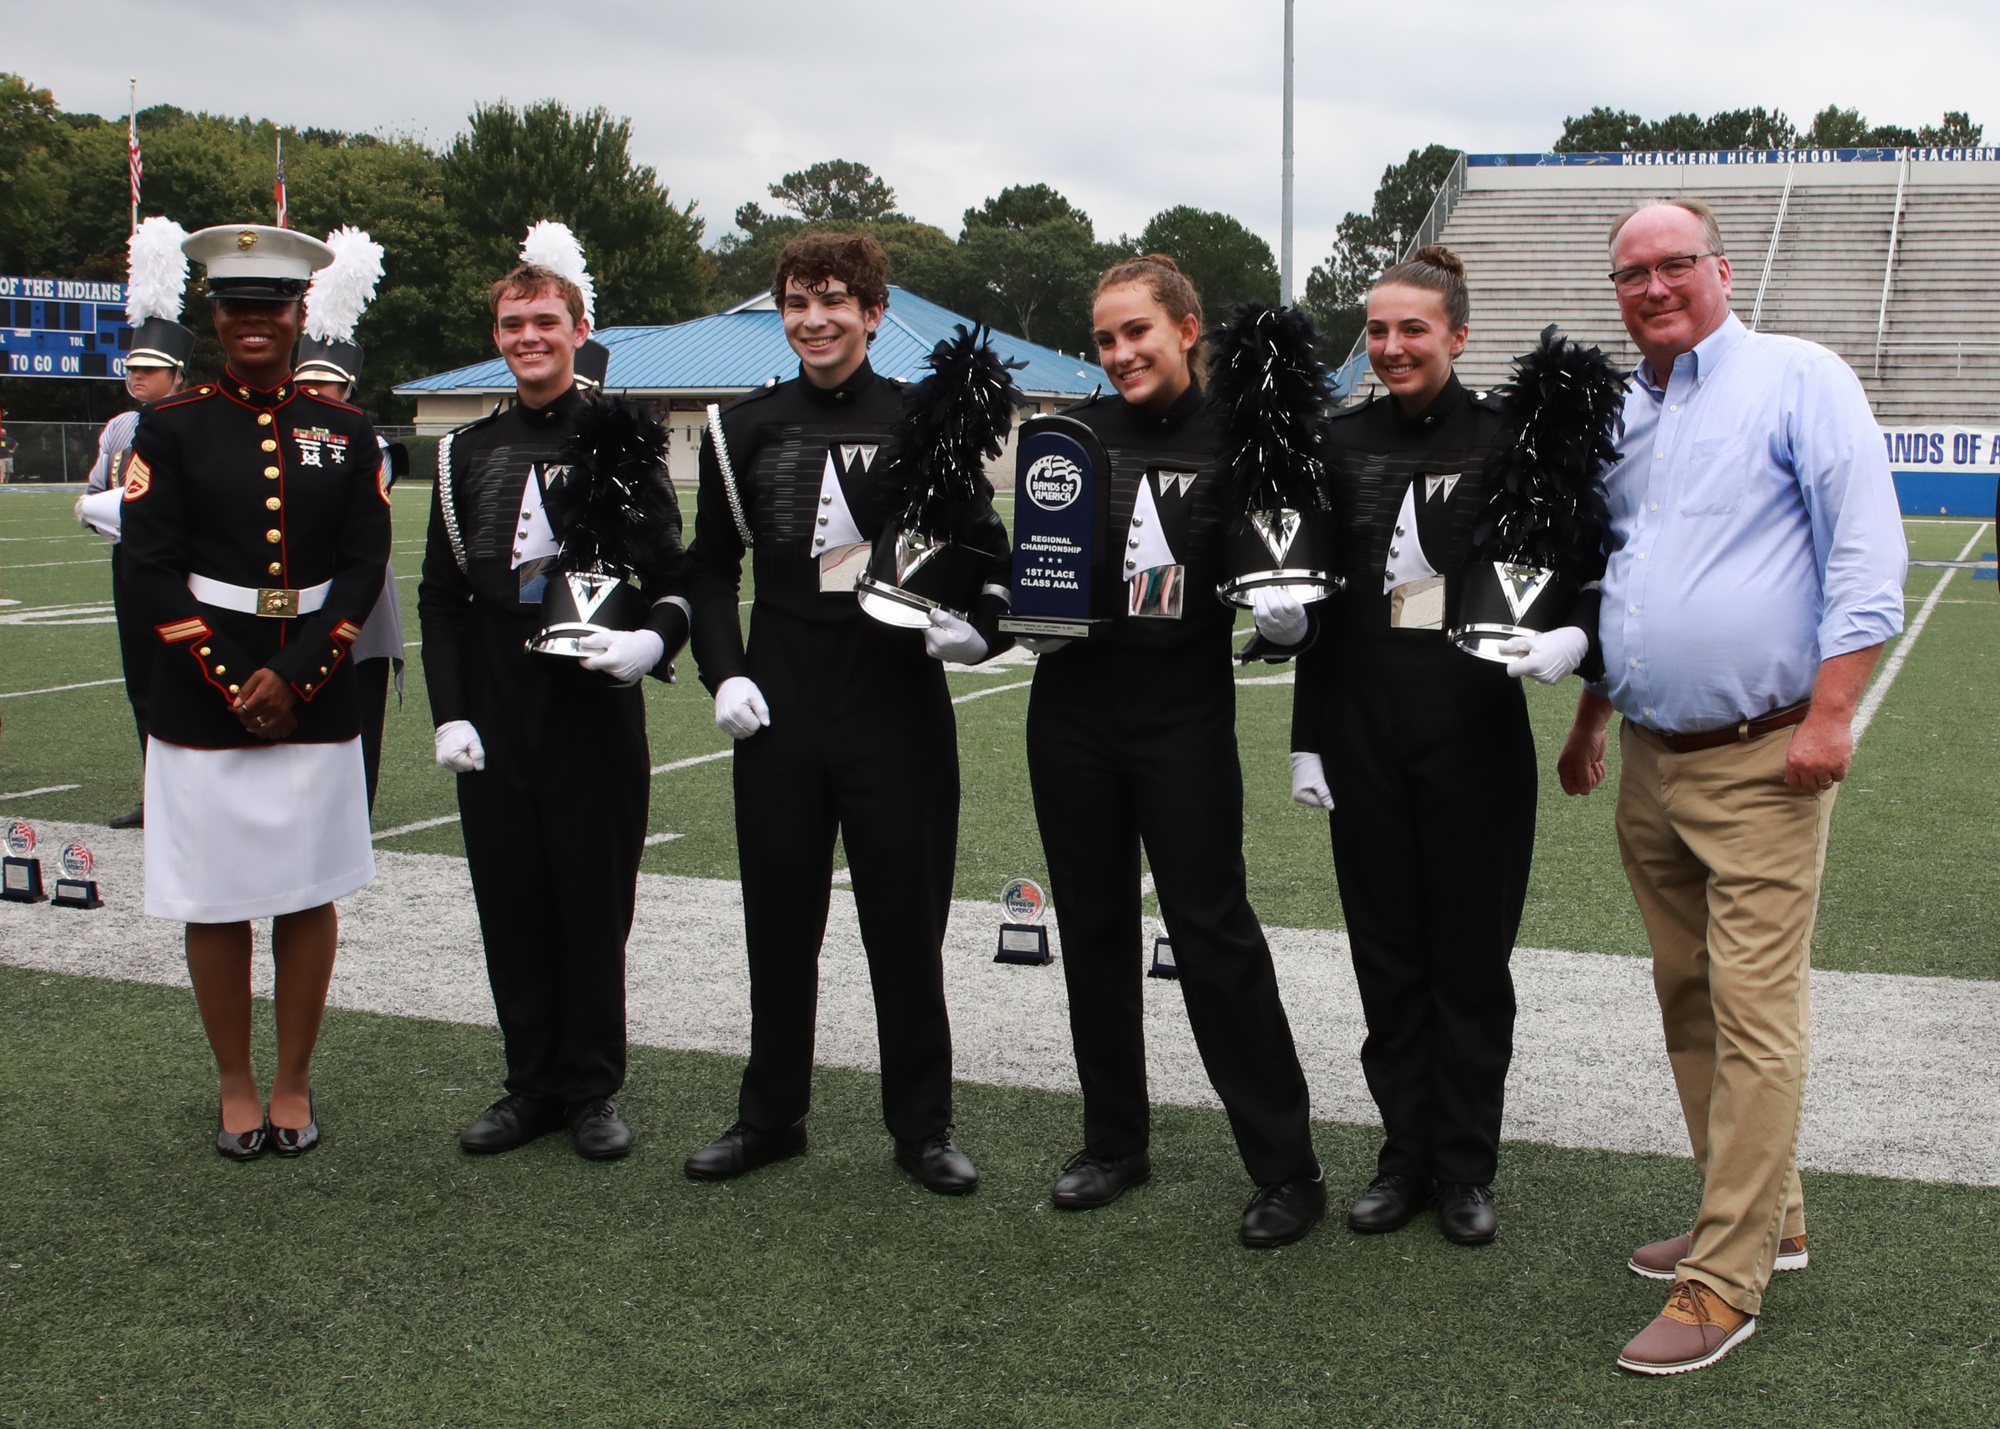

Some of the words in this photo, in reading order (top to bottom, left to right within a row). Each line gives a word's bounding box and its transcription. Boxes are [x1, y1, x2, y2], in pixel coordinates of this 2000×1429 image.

[1622, 151, 1718, 165] MCEACHERN
[1727, 151, 1767, 164] HIGH
[1776, 150, 1841, 163] SCHOOL
[1895, 148, 1996, 161] MCEACHERN
[0, 277, 19, 296] OF
[23, 279, 54, 297] THE
[57, 281, 121, 300] INDIANS
[69, 337, 84, 347] TOL
[11, 354, 29, 371] TO
[34, 355, 52, 372] GO
[61, 356, 79, 373] ON
[1953, 433, 1982, 464] OF
[1032, 481, 1060, 492] BANDS
[1061, 483, 1074, 492] OF
[1035, 490, 1071, 501] AMERICA
[1031, 535, 1072, 544] REGIONAL
[1020, 543, 1082, 554] CHAMPIONSHIP
[1025, 568, 1043, 577] 1ST
[1045, 569, 1075, 579] PLACE
[1020, 578, 1051, 588] CLASS
[1052, 580, 1079, 590] AAAA
